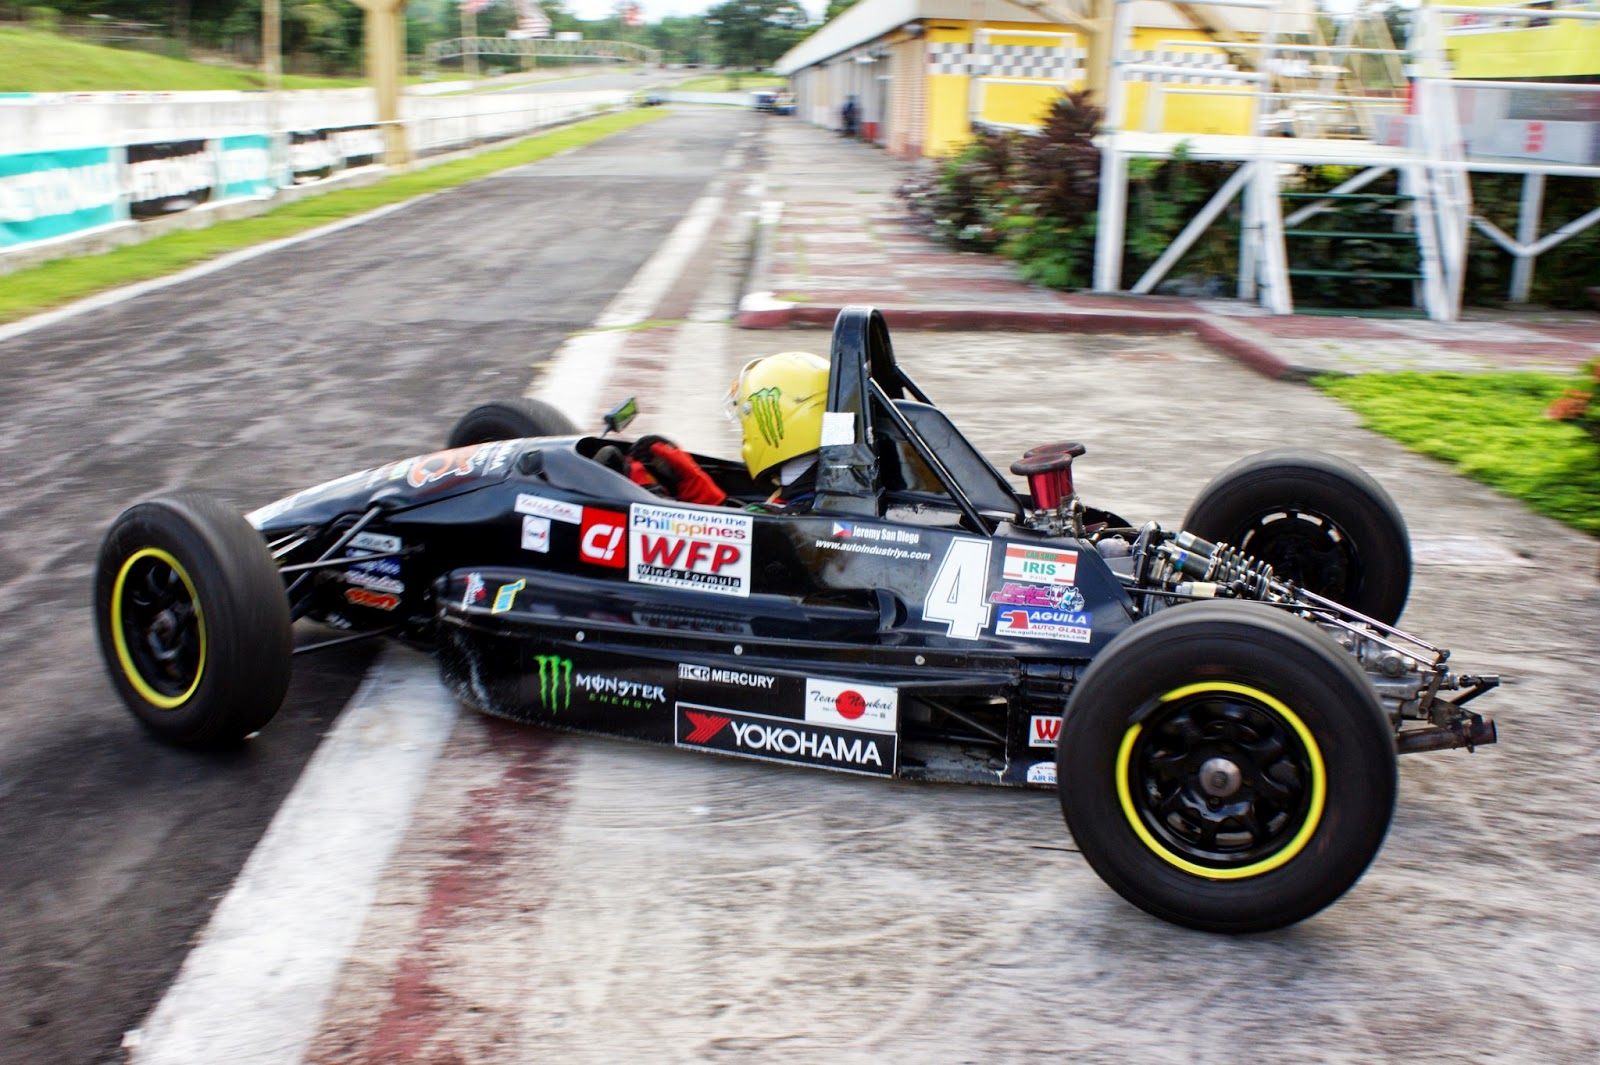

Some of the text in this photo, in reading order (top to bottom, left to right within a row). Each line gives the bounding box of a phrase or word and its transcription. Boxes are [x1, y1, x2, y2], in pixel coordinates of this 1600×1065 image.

[634, 515, 746, 540] Philippines
[652, 510, 685, 520] more
[688, 512, 709, 523] fun
[711, 516, 722, 524] in
[725, 517, 747, 527] the
[852, 525, 920, 545] Jeremy San Diego
[640, 534, 741, 574] WFP
[815, 539, 932, 561] www.autoindustriya.com
[637, 564, 740, 587] Winds Formula
[1023, 561, 1057, 576] IRIS
[922, 536, 993, 641] 4
[1030, 611, 1087, 625] AGUILA
[1031, 624, 1088, 636] AUTO GLASS
[711, 669, 775, 689] MERCURY
[588, 692, 653, 710] ENERGY
[810, 690, 842, 705] Team
[730, 720, 883, 767] YOKOHAMA
[1032, 774, 1046, 782] AIR
